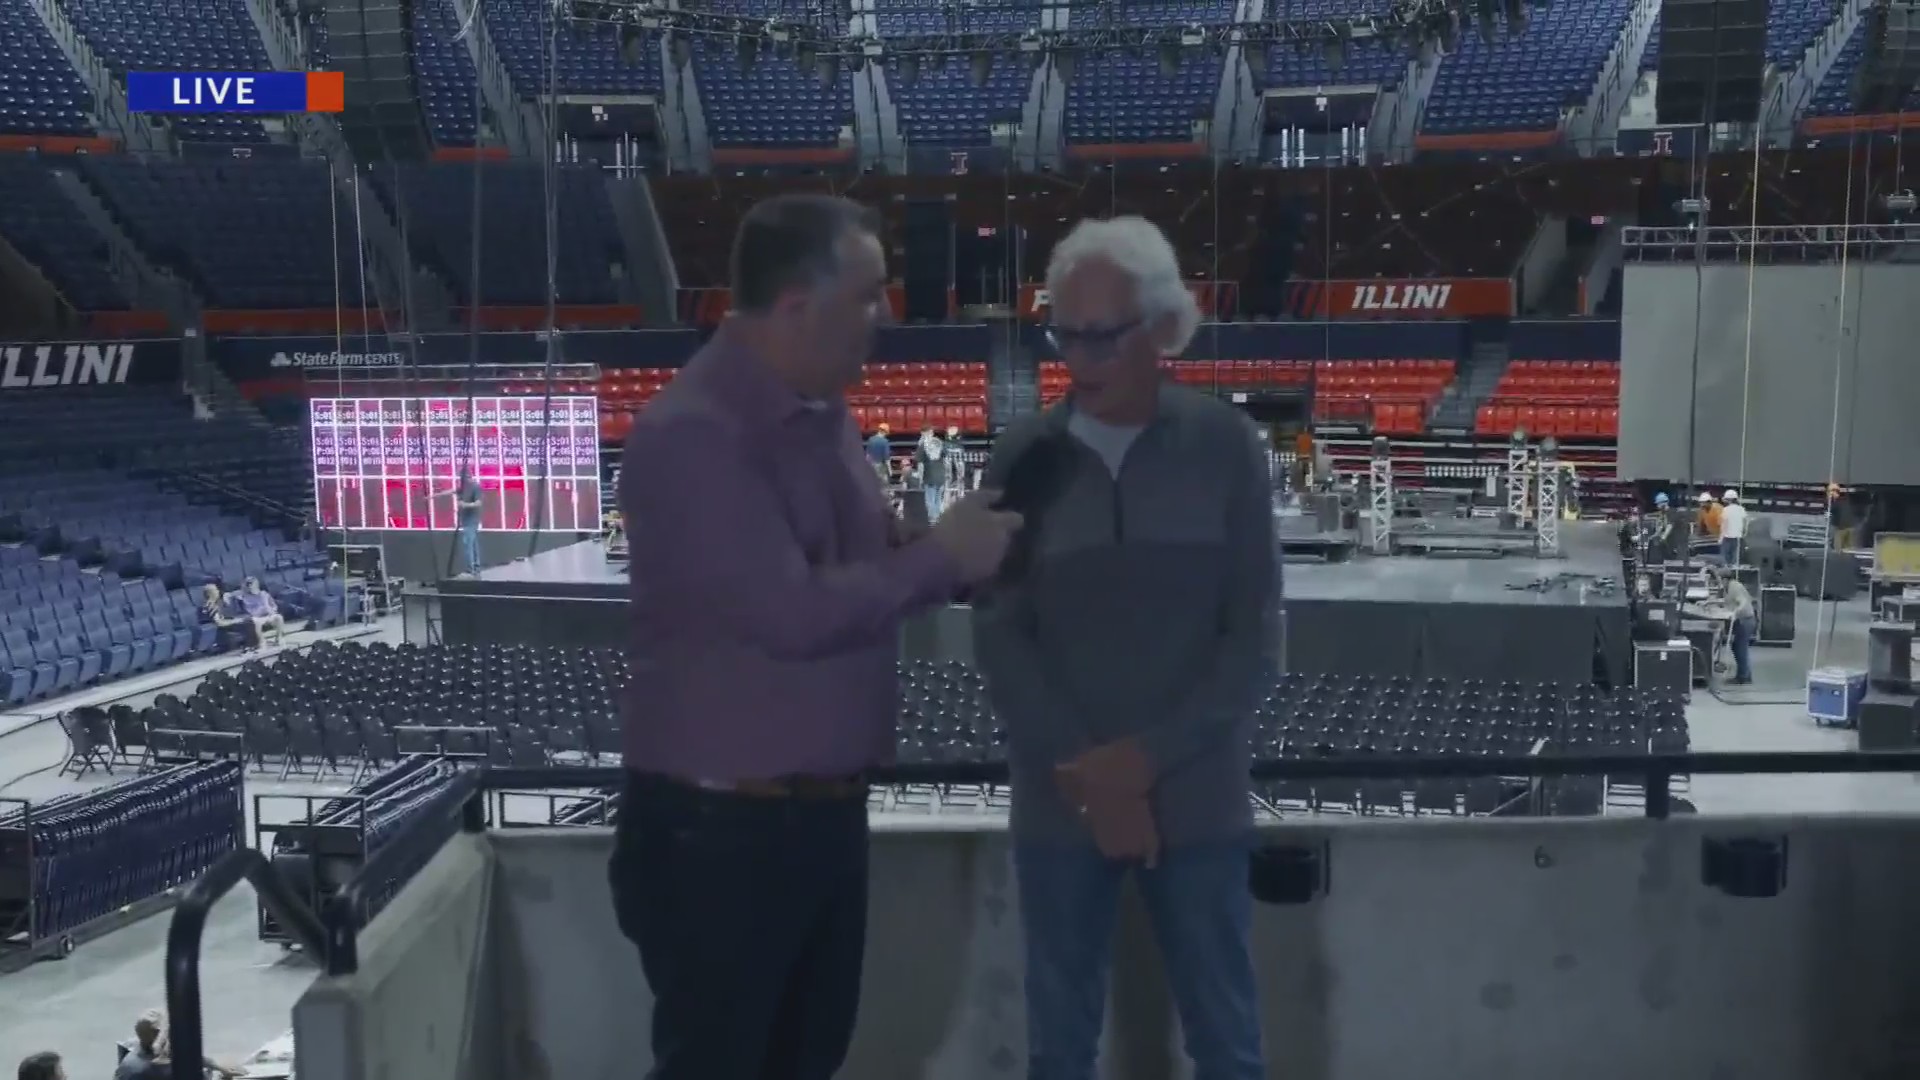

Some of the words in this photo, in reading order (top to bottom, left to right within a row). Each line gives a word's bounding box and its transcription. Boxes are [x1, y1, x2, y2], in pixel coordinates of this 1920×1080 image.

[1351, 284, 1452, 309] ILLINI
[0, 344, 134, 387] LLINI
[365, 352, 404, 364] CENTE
